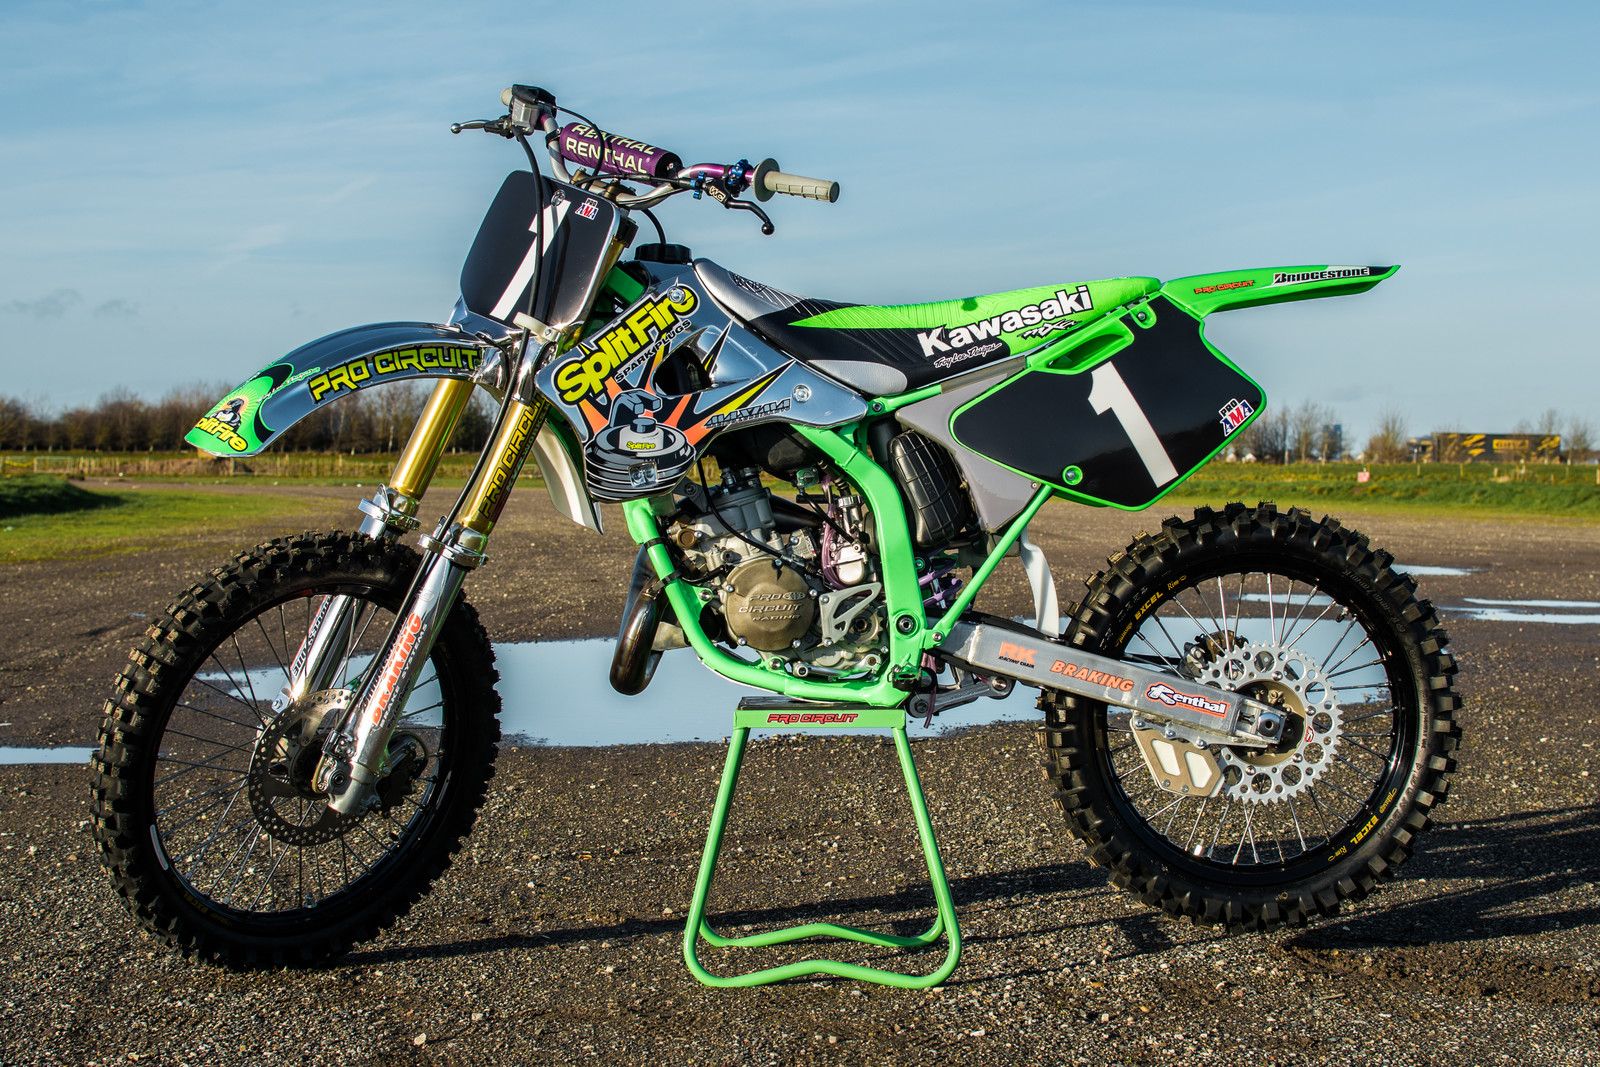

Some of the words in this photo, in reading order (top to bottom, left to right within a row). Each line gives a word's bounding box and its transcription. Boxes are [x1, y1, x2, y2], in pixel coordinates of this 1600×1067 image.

[566, 137, 647, 174] RENTHAL
[576, 203, 599, 219] AMA
[1194, 285, 1216, 295] PRO
[1217, 280, 1255, 291] CIRCUIT
[1274, 267, 1370, 284] BRIDGESTONE
[917, 285, 1094, 357] Kawasaki
[556, 287, 697, 403] SplitFire
[614, 350, 656, 383] SPARK
[653, 319, 692, 353] PLUGS
[308, 358, 371, 403] PRO
[374, 347, 479, 374] CIRCUIT
[1219, 399, 1238, 417] PRO
[1221, 400, 1254, 436] AMA
[1087, 361, 1179, 489] 1
[627, 441, 656, 450] SplitFire
[478, 467, 507, 518] PRO
[738, 604, 802, 613] CIRCUIT
[749, 593, 783, 601] PRO
[1135, 591, 1163, 620] EXCEL
[402, 623, 428, 679] SYSTEMS
[1000, 641, 1038, 666] RK
[1049, 660, 1135, 692] BRAKING
[767, 713, 800, 724] PRO
[800, 713, 858, 724] CIRCUIT
[1350, 815, 1379, 844] EXCEL
